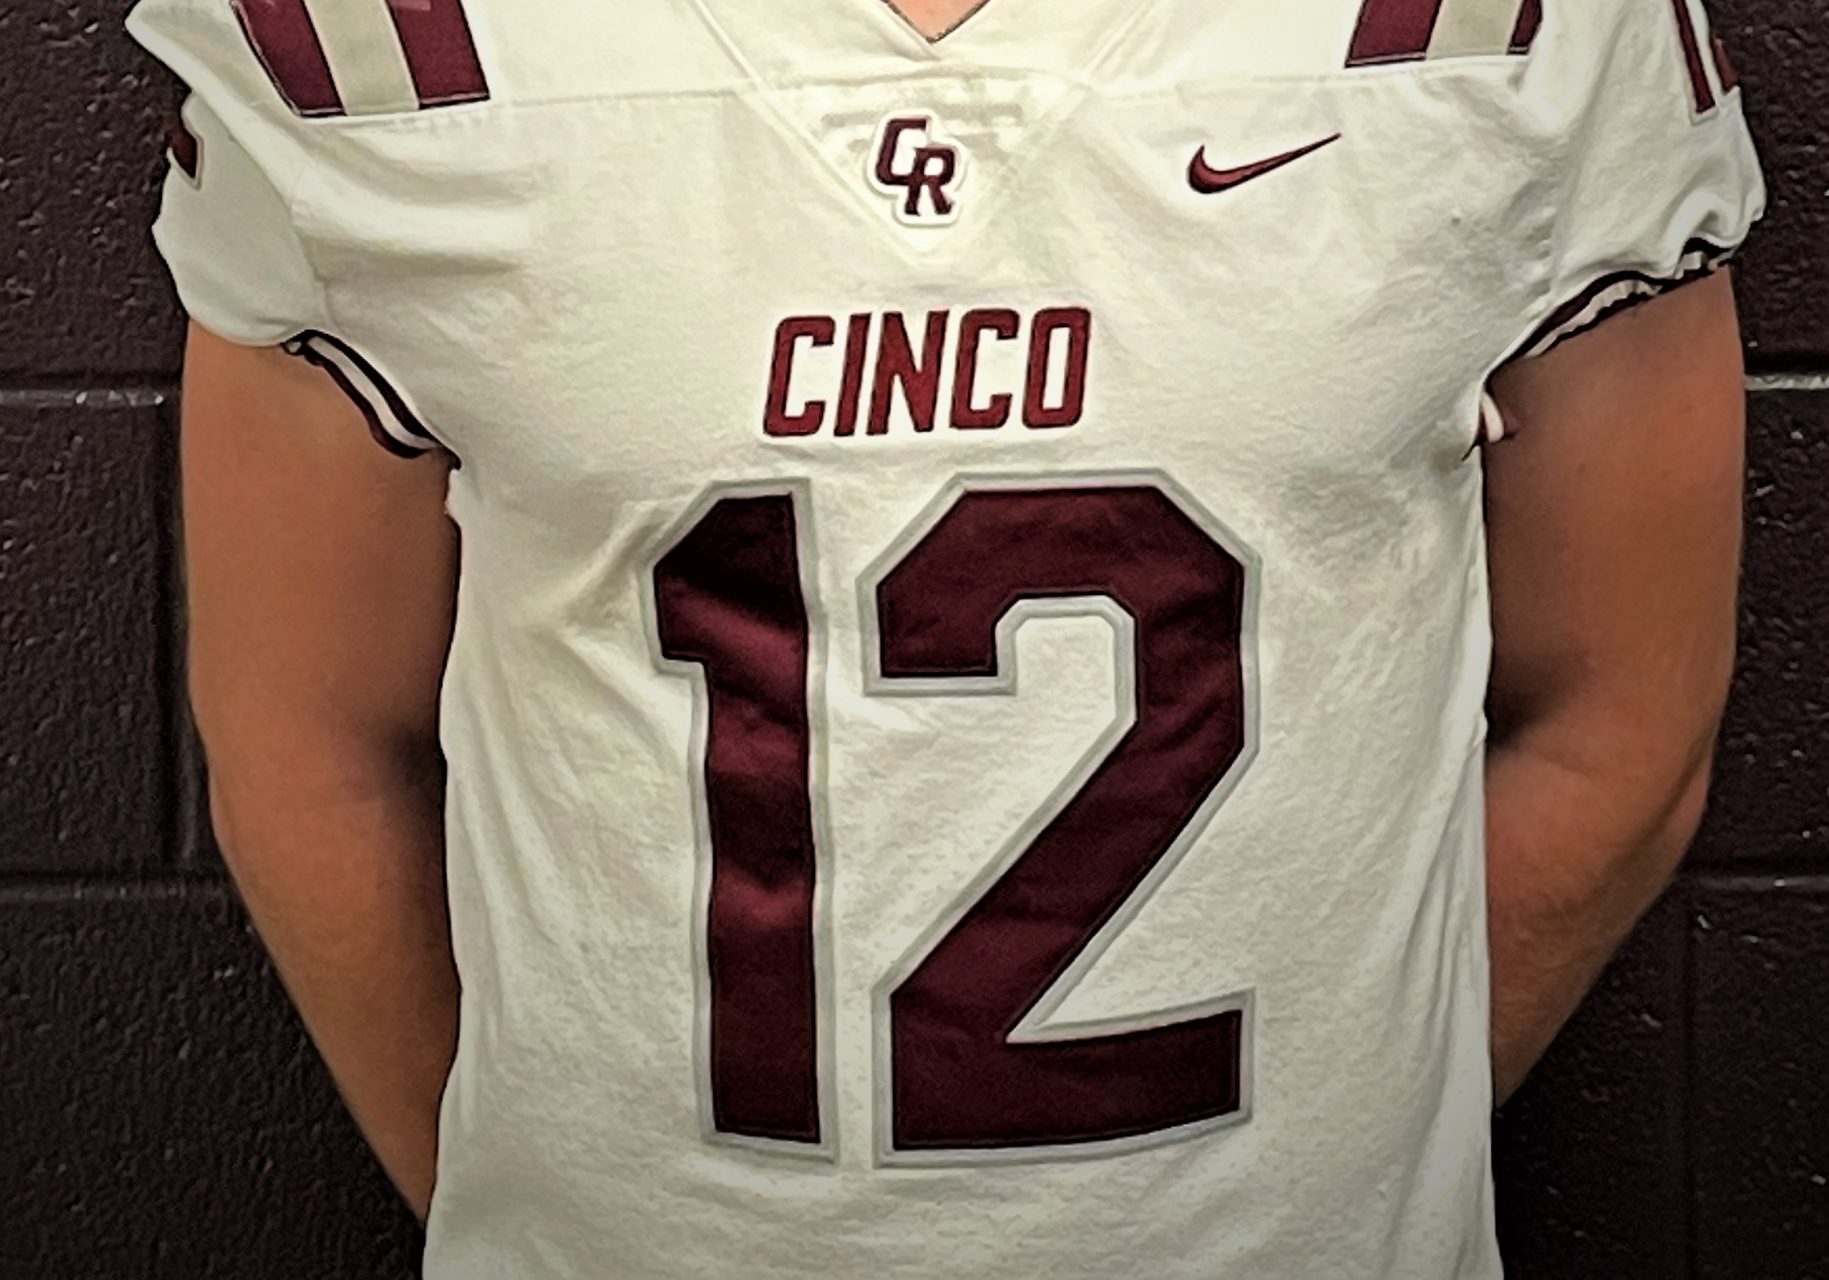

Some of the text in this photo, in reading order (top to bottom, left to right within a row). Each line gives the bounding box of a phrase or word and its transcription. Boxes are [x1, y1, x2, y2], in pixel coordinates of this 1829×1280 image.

[876, 117, 957, 216] CR
[763, 306, 1092, 437] CINCO
[642, 470, 1260, 1166] 12
